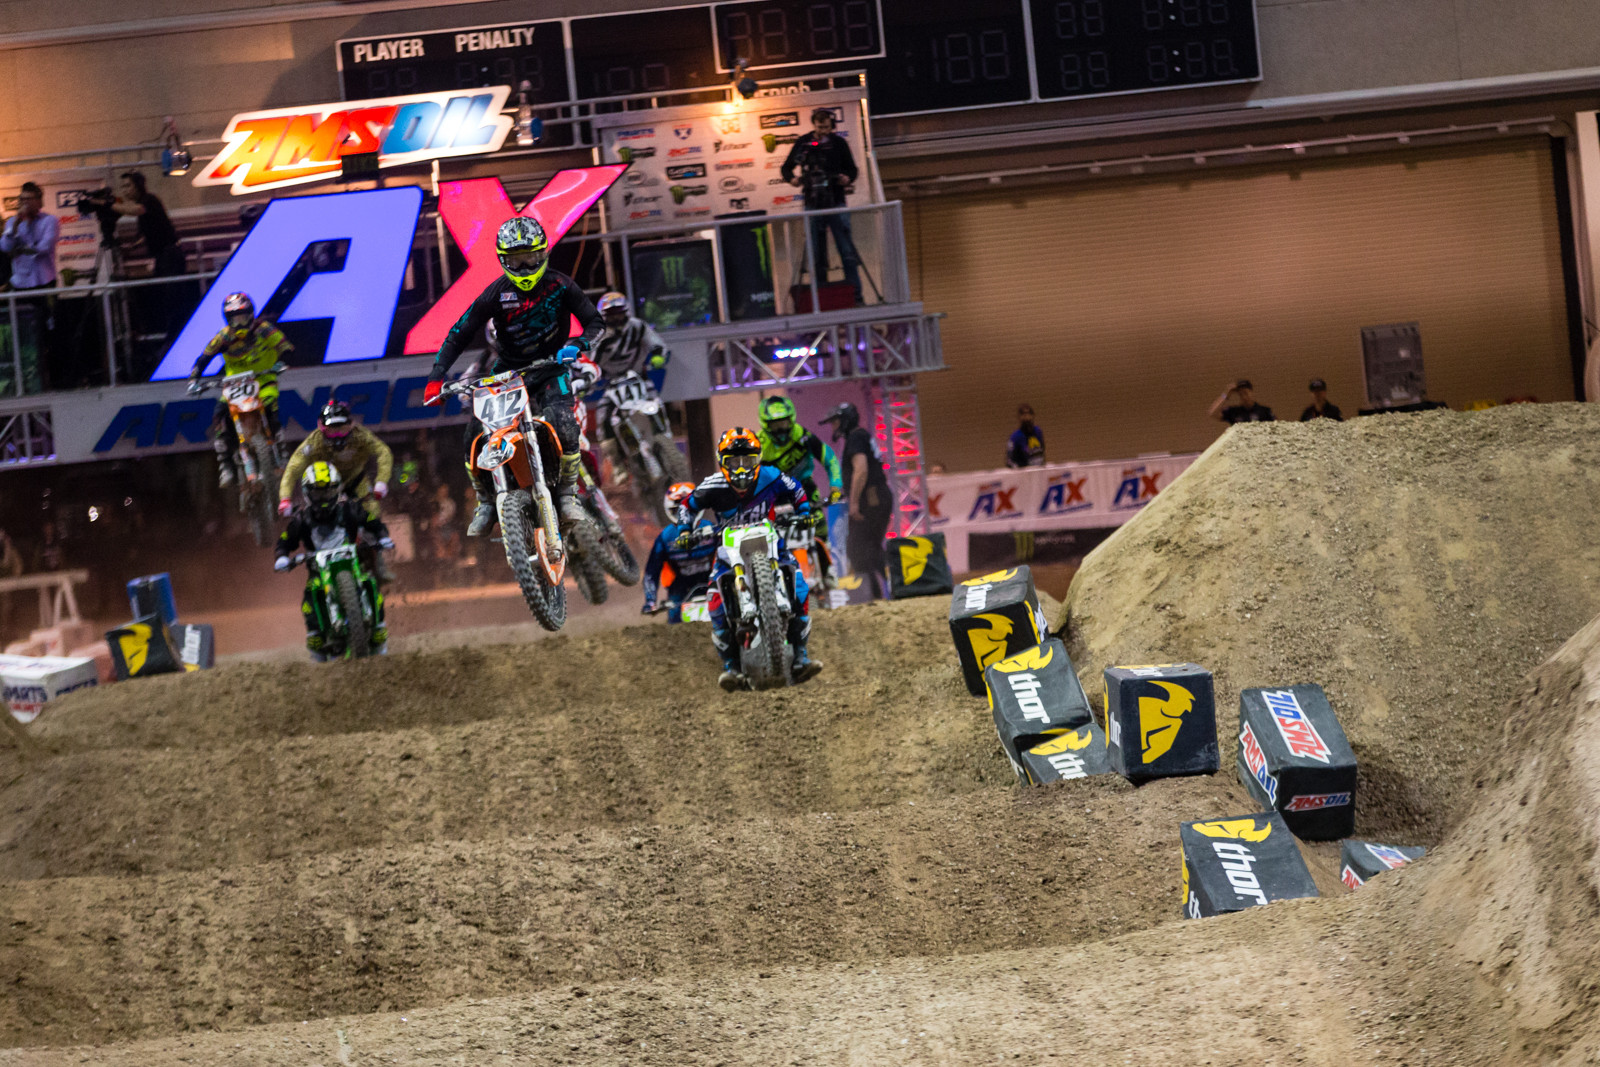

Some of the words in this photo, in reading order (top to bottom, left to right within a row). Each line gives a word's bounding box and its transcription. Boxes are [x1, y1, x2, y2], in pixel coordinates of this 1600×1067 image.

[353, 38, 425, 63] PLAYER
[455, 27, 535, 53] PENALTY
[208, 92, 495, 186] AMSOIL
[230, 383, 256, 399] 20
[480, 388, 522, 423] 412
[968, 486, 1018, 520] AX
[1039, 478, 1089, 512] AX
[1113, 471, 1162, 505] AX
[1007, 673, 1051, 724] thor
[1263, 692, 1330, 763] AMSOIL
[1241, 722, 1277, 804] AMSOIL
[1286, 793, 1350, 811] AMSOIL
[1212, 842, 1268, 905] thor
